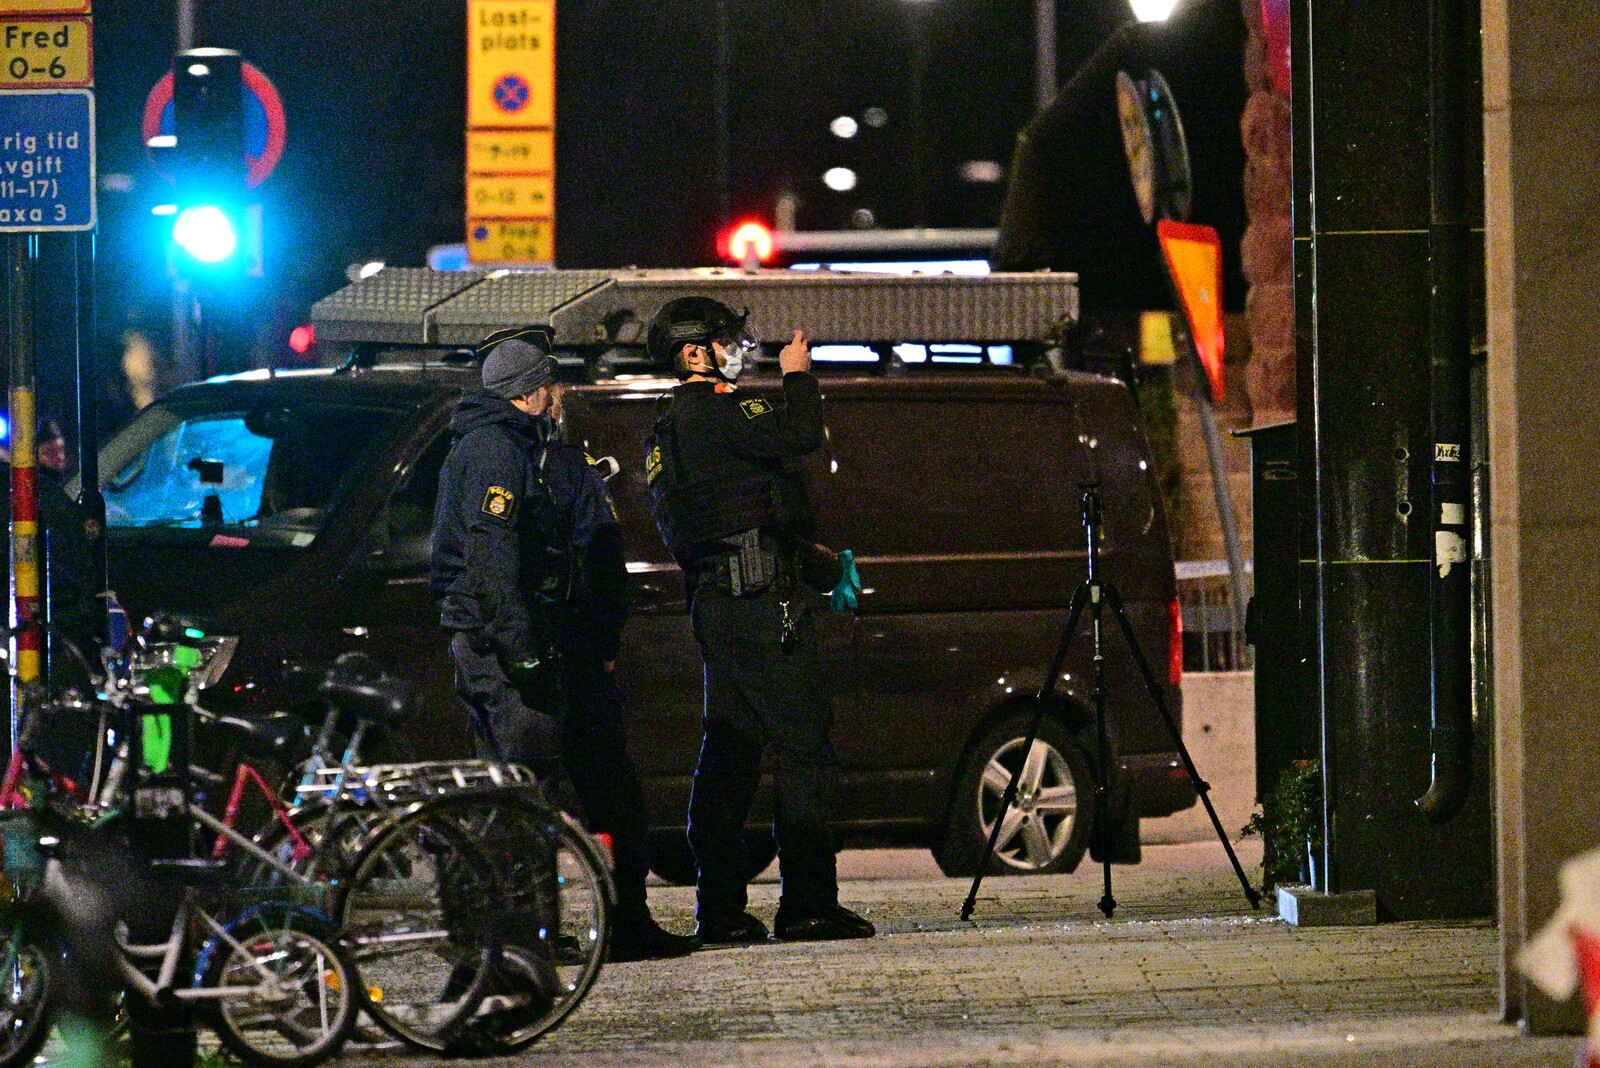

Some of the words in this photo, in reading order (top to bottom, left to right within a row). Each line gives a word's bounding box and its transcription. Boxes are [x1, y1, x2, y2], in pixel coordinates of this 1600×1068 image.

[478, 8, 541, 28] Last-
[5, 25, 69, 48] Fred
[480, 34, 540, 53] plats
[8, 56, 67, 79] 0-6
[48, 131, 79, 150] tid
[0, 156, 62, 178] vgift
[53, 203, 67, 222] 3
[489, 487, 514, 501] POLIS
